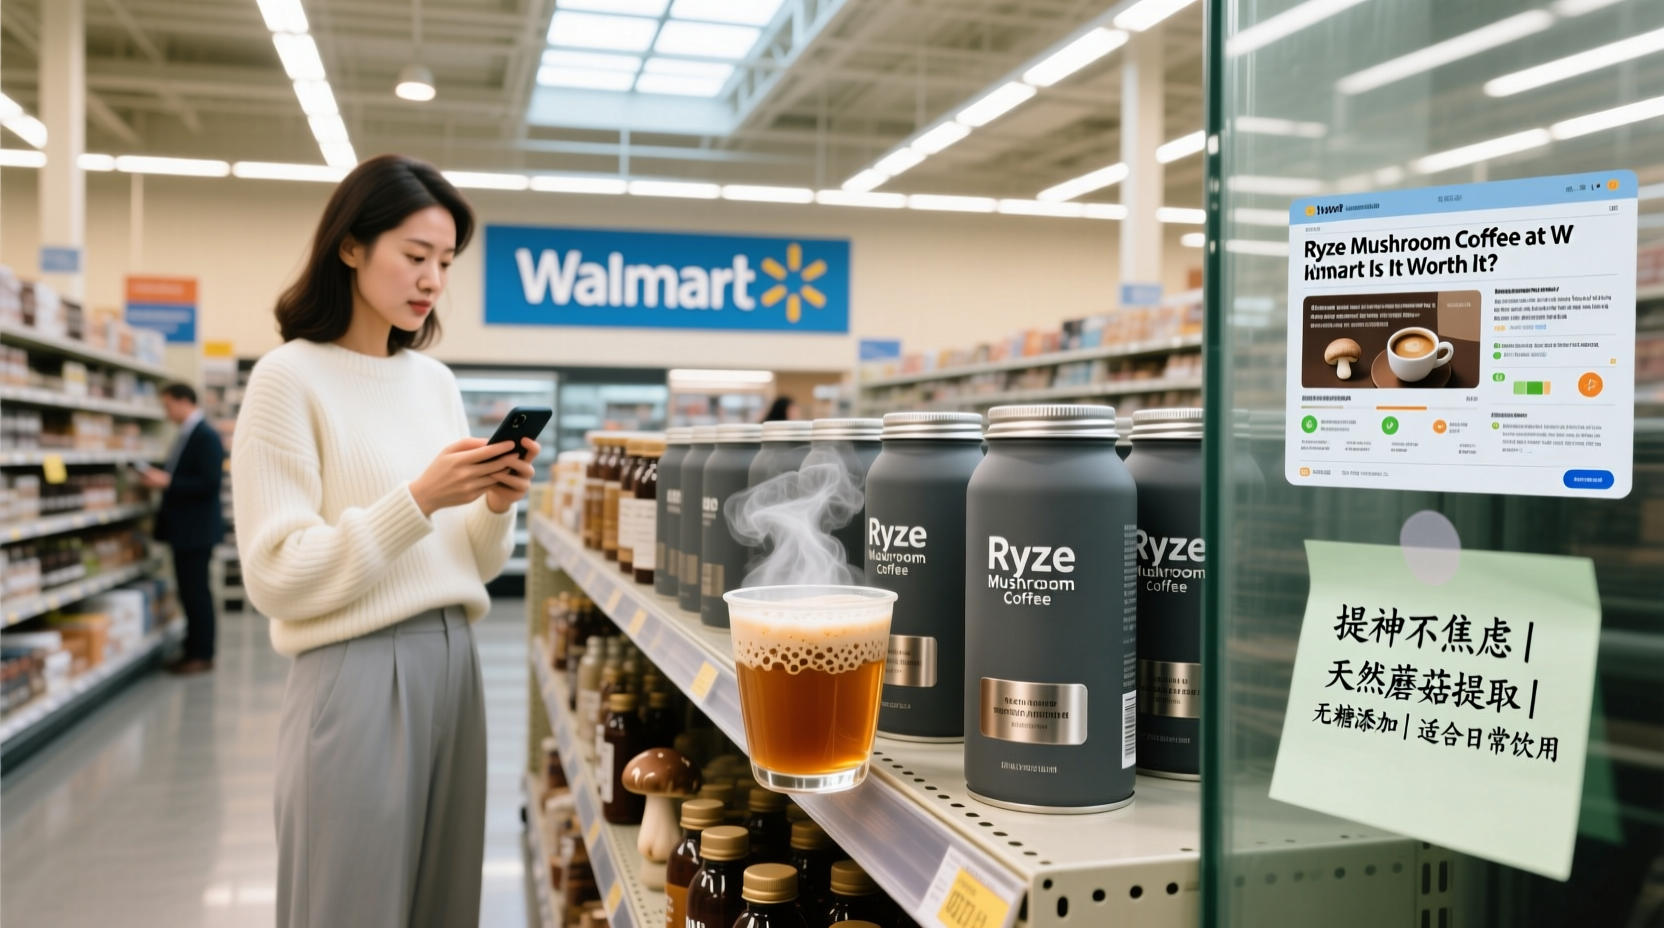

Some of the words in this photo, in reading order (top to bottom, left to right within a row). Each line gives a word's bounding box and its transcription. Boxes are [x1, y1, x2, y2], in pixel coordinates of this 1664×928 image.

[1304, 240, 1347, 262] Ryze
[1350, 233, 1451, 255] Mushroom
[1454, 226, 1521, 249] Coffee
[1524, 227, 1547, 246] at
[1550, 224, 1575, 245] W
[514, 247, 757, 312] Walmart
[1369, 259, 1384, 278] Is
[1389, 258, 1404, 277] It
[1406, 254, 1468, 276] Worth
[1472, 253, 1498, 273] It?
[868, 517, 928, 552] Ryze
[1136, 528, 1206, 567] Ryze
[988, 535, 1076, 578] Ryze
[988, 573, 1075, 591] Mushroom
[1003, 591, 1052, 606] Coffee
[1146, 580, 1188, 593] Coffee
